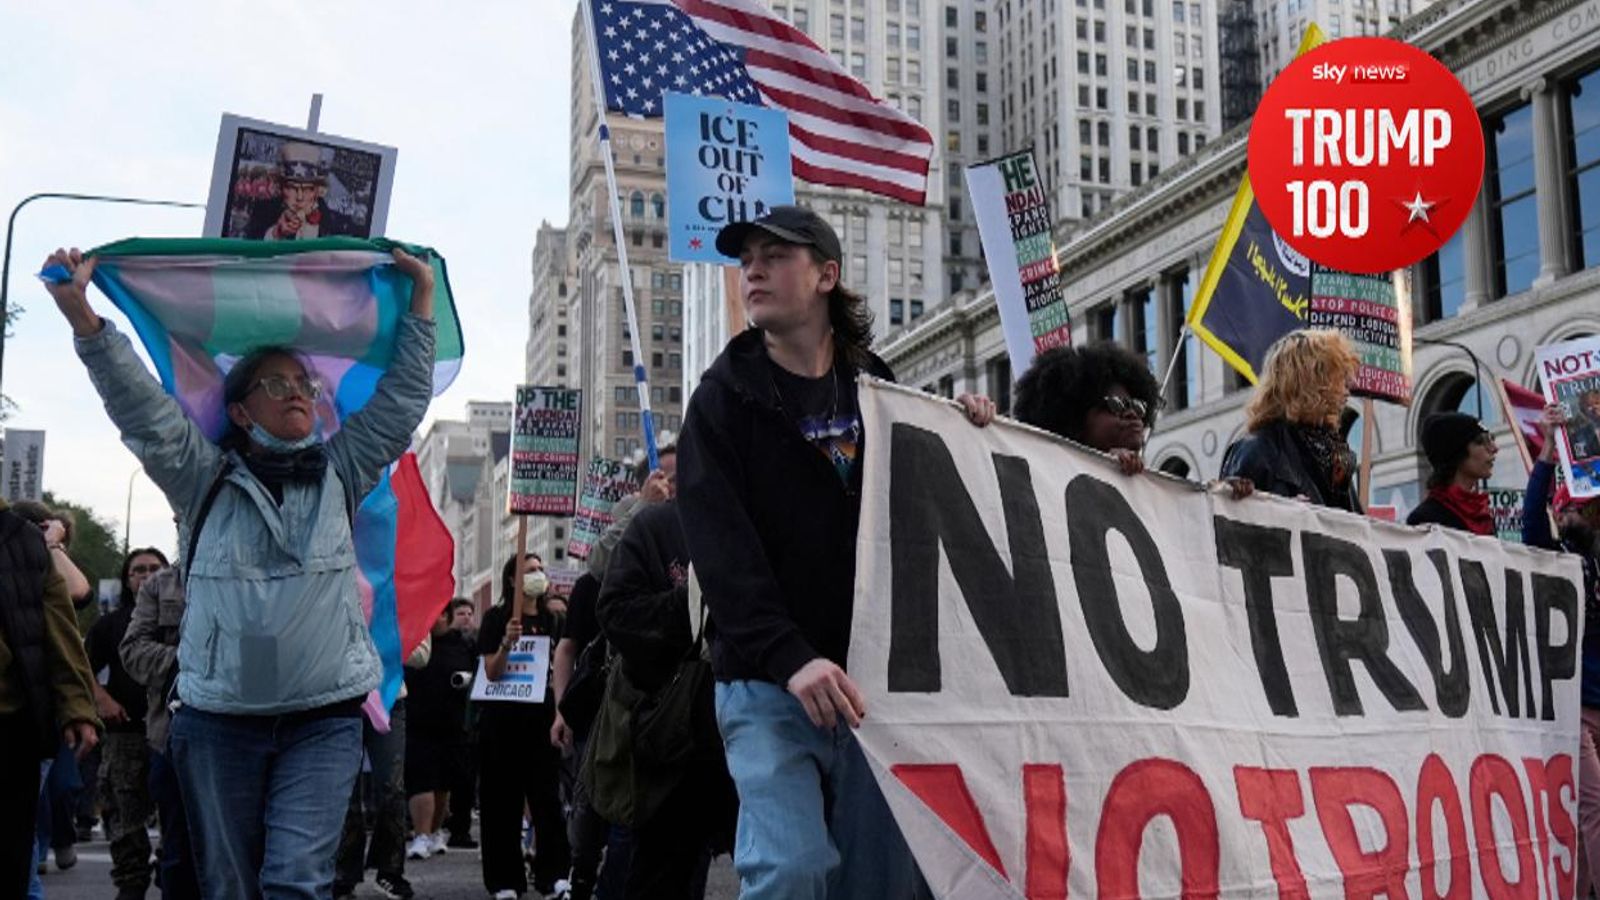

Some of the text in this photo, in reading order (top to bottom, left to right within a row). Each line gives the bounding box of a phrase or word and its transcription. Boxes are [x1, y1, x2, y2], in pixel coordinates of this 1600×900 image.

[700, 112, 759, 149] ICE
[698, 144, 764, 177] OUT
[717, 173, 748, 194] OF
[999, 155, 1037, 192] HE
[1311, 298, 1345, 311] STOP
[1311, 311, 1356, 326] DEFEND
[1544, 349, 1594, 378] NOT
[542, 391, 577, 410] THE
[888, 422, 1578, 721] NO TRUMP
[485, 684, 533, 698] CHICAGO
